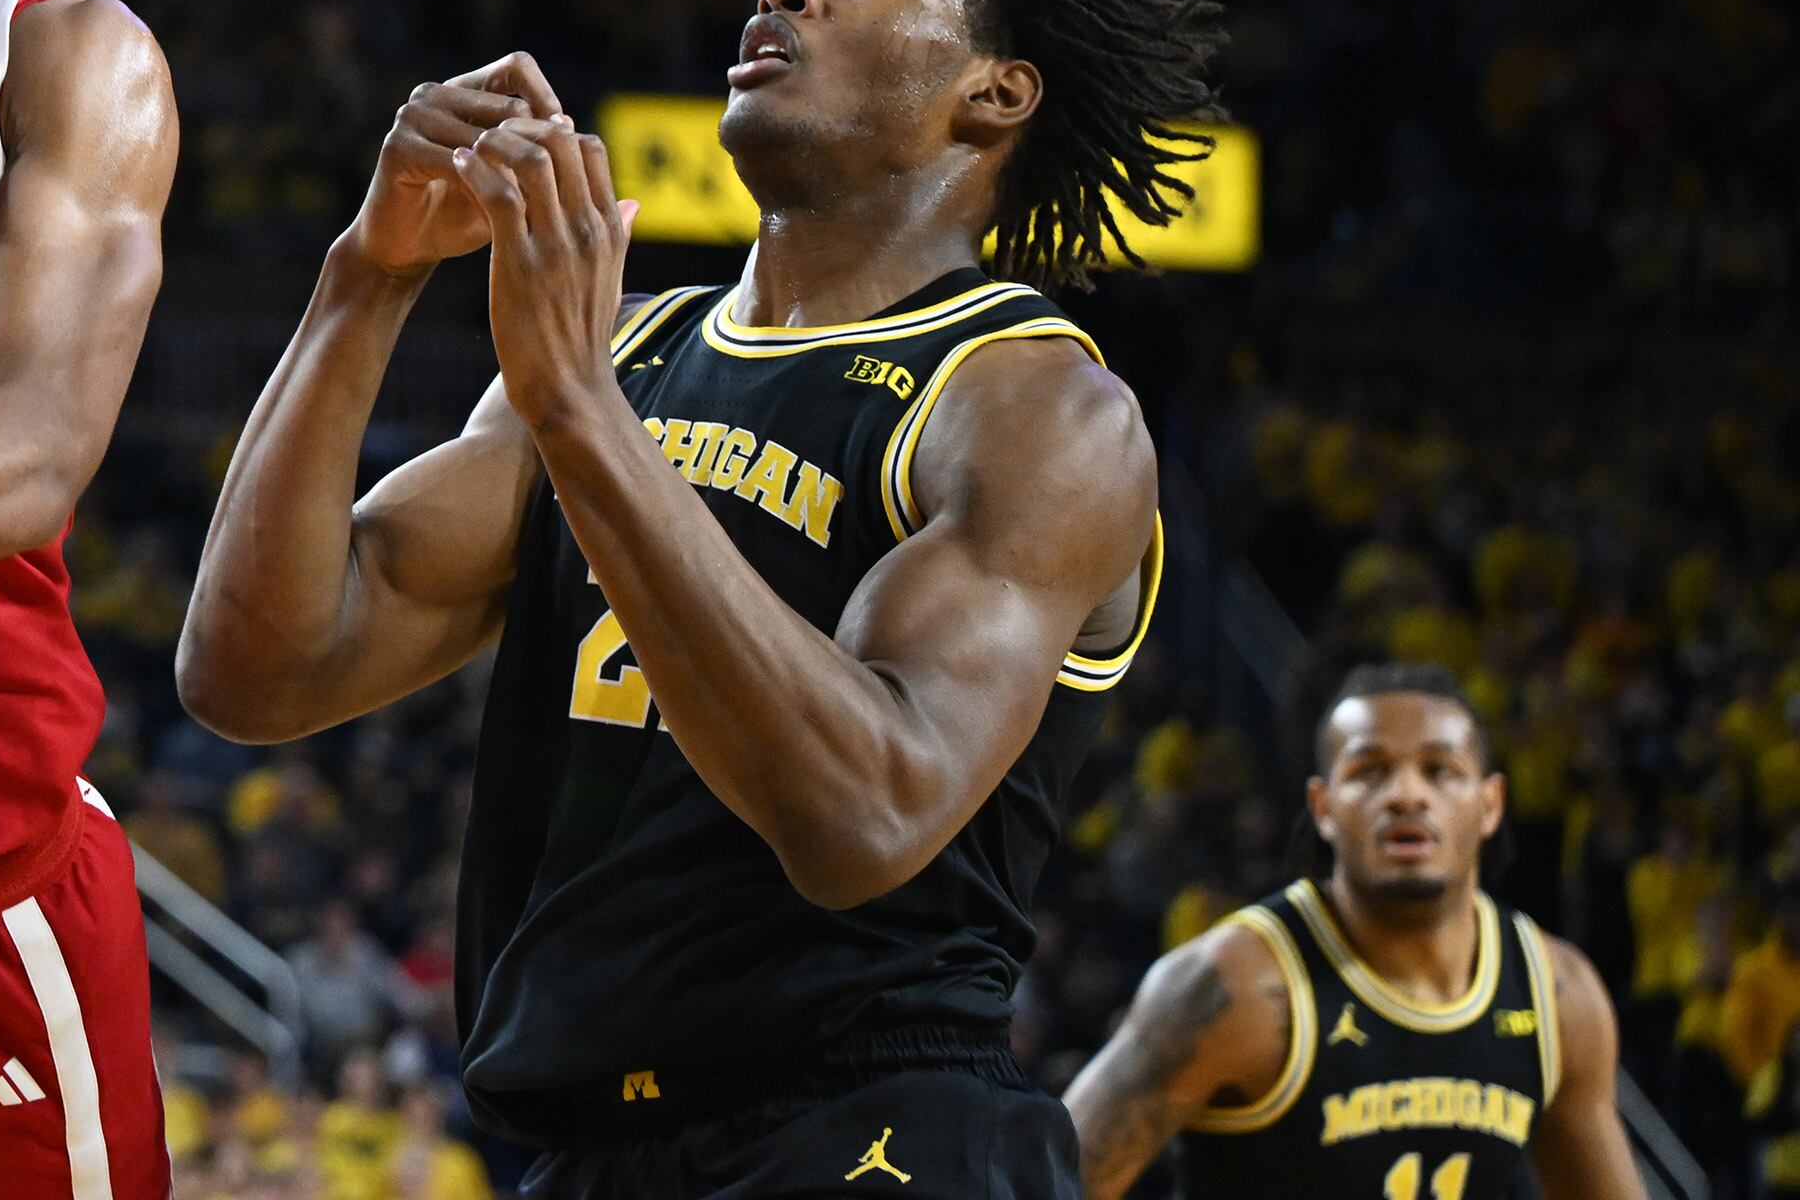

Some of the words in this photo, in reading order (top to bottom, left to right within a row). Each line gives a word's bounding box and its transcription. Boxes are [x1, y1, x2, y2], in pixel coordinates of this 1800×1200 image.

[638, 416, 845, 550] HIGAN
[623, 1070, 661, 1101] M
[1320, 1076, 1536, 1149] MICHIGAN
